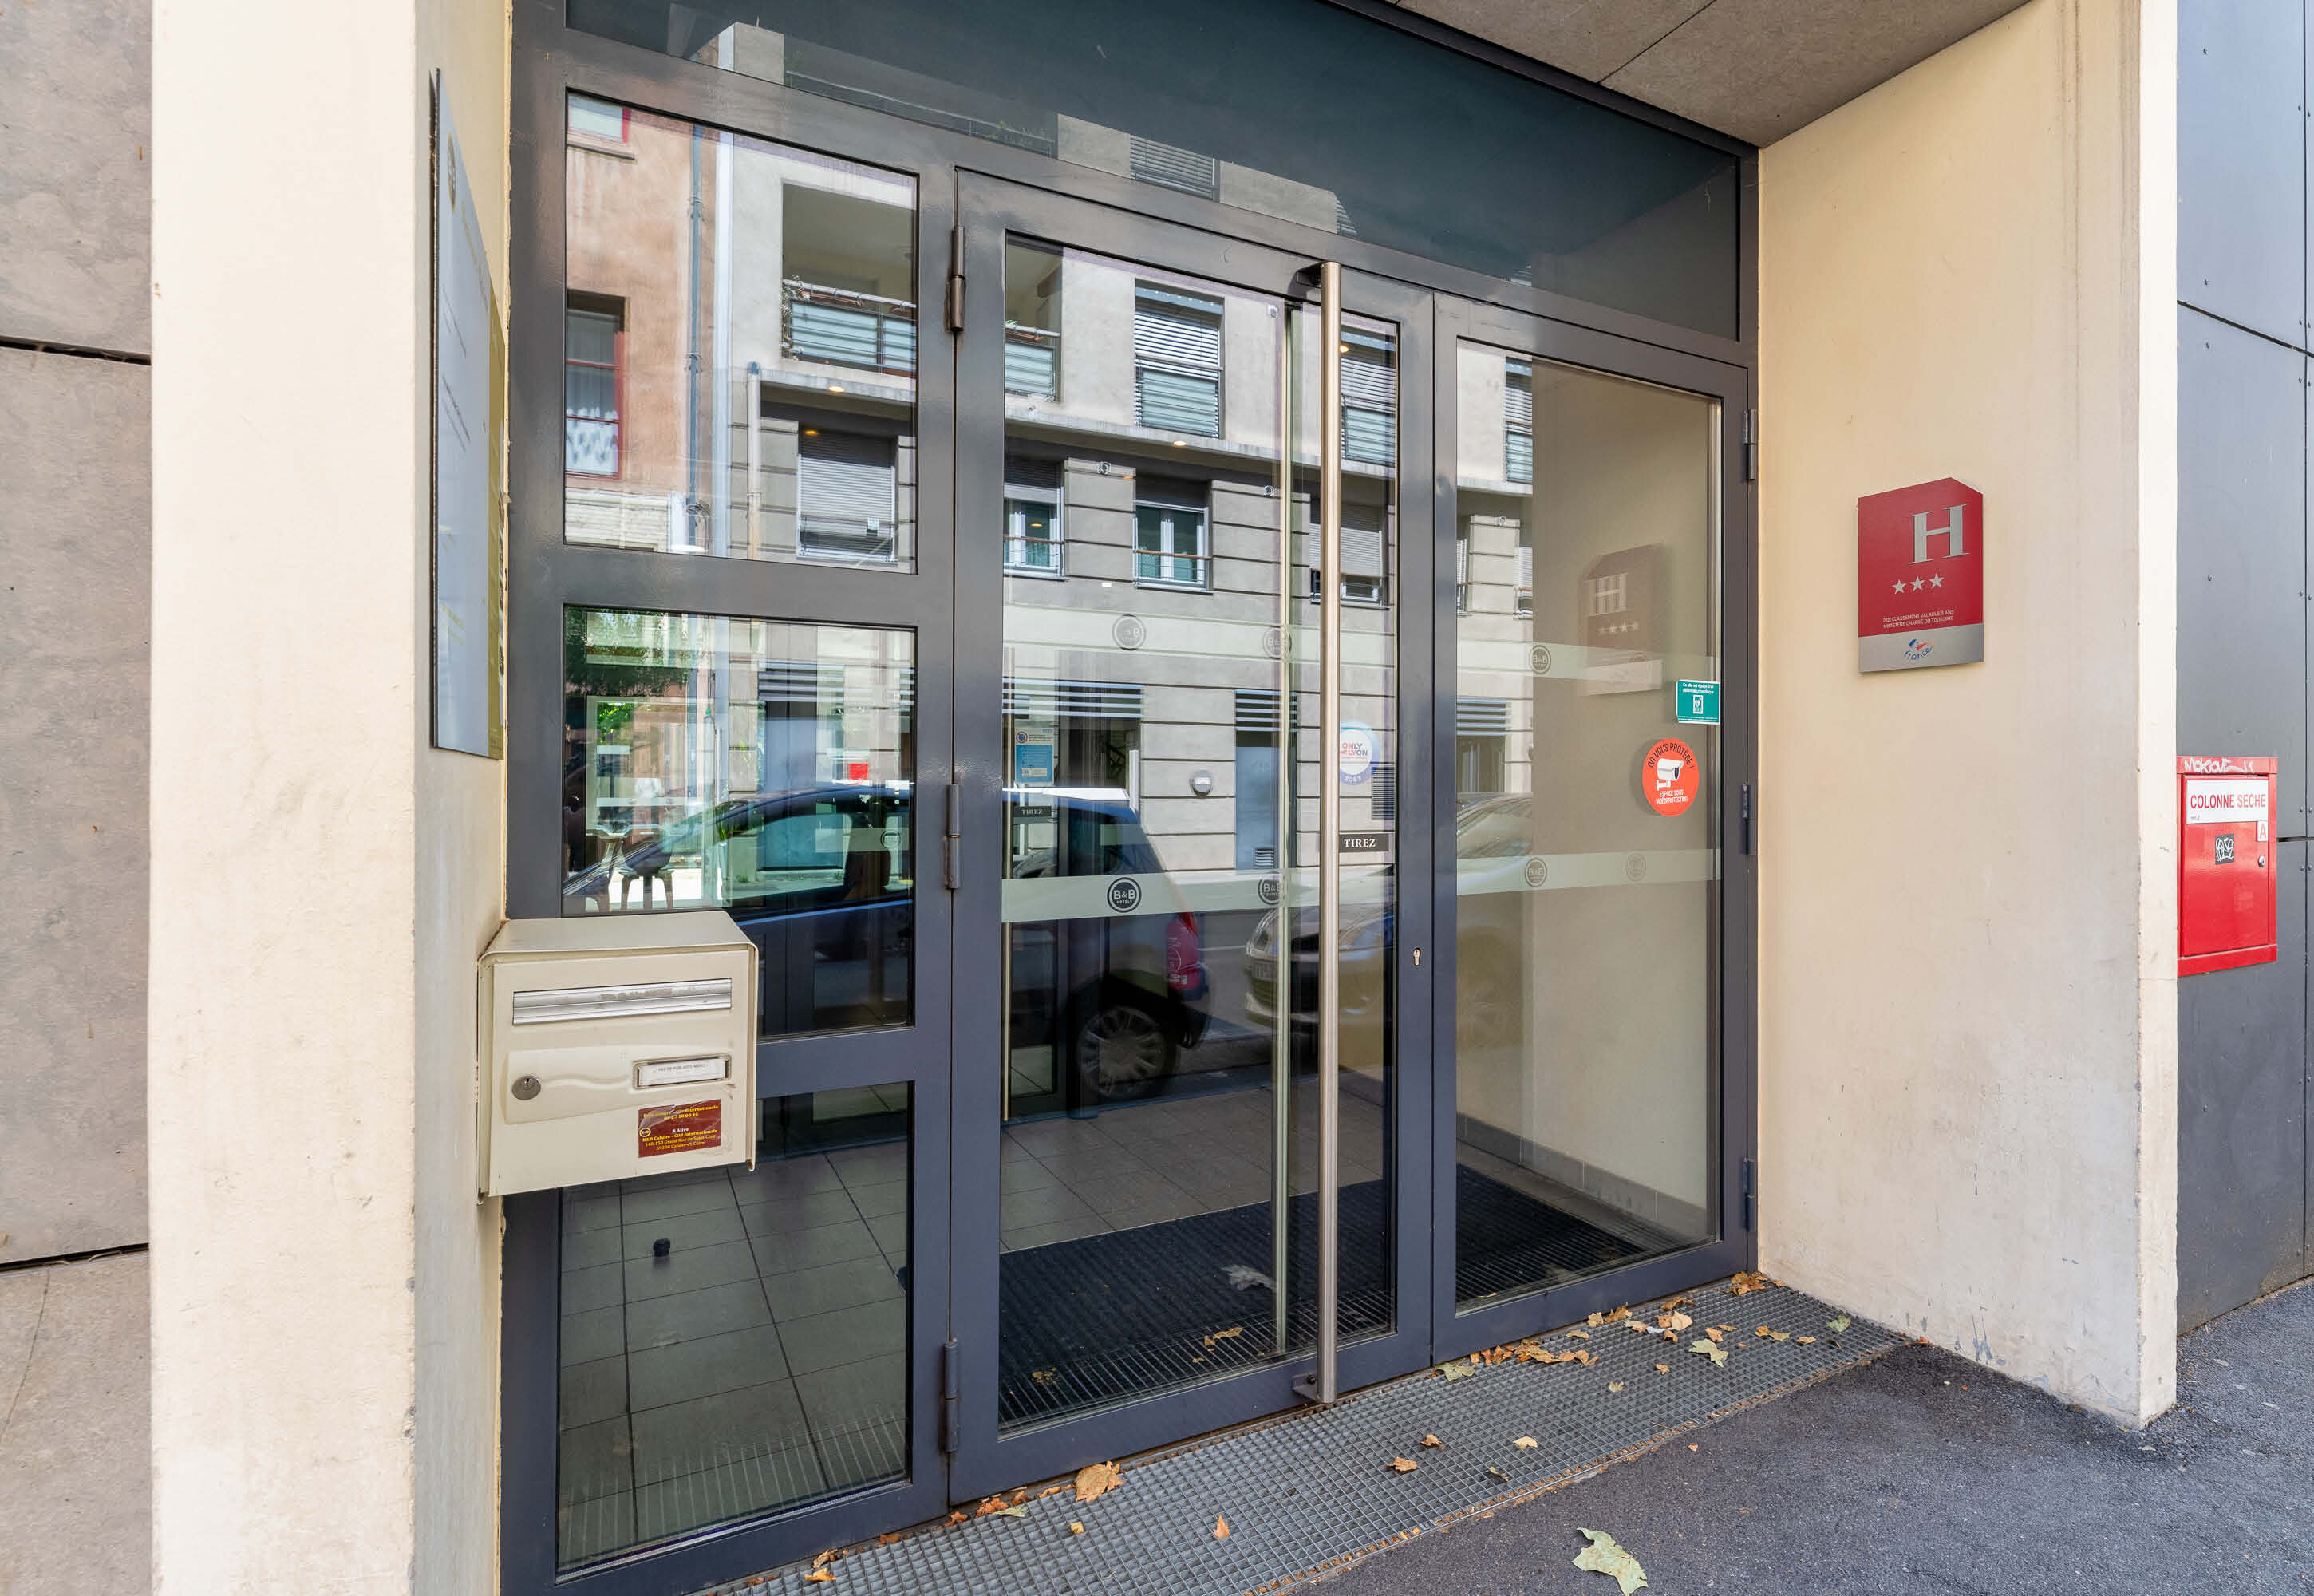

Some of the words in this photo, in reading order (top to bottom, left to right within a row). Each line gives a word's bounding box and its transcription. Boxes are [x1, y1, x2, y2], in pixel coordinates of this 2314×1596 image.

[1908, 503, 1971, 565] H
[1653, 743, 1668, 758] VOUS
[2190, 794, 2235, 809] COLONNE
[2237, 794, 2266, 808] SECHE
[2259, 823, 2267, 839] A
[1344, 838, 1376, 848] TIREZ
[1113, 889, 1136, 900] B&B
